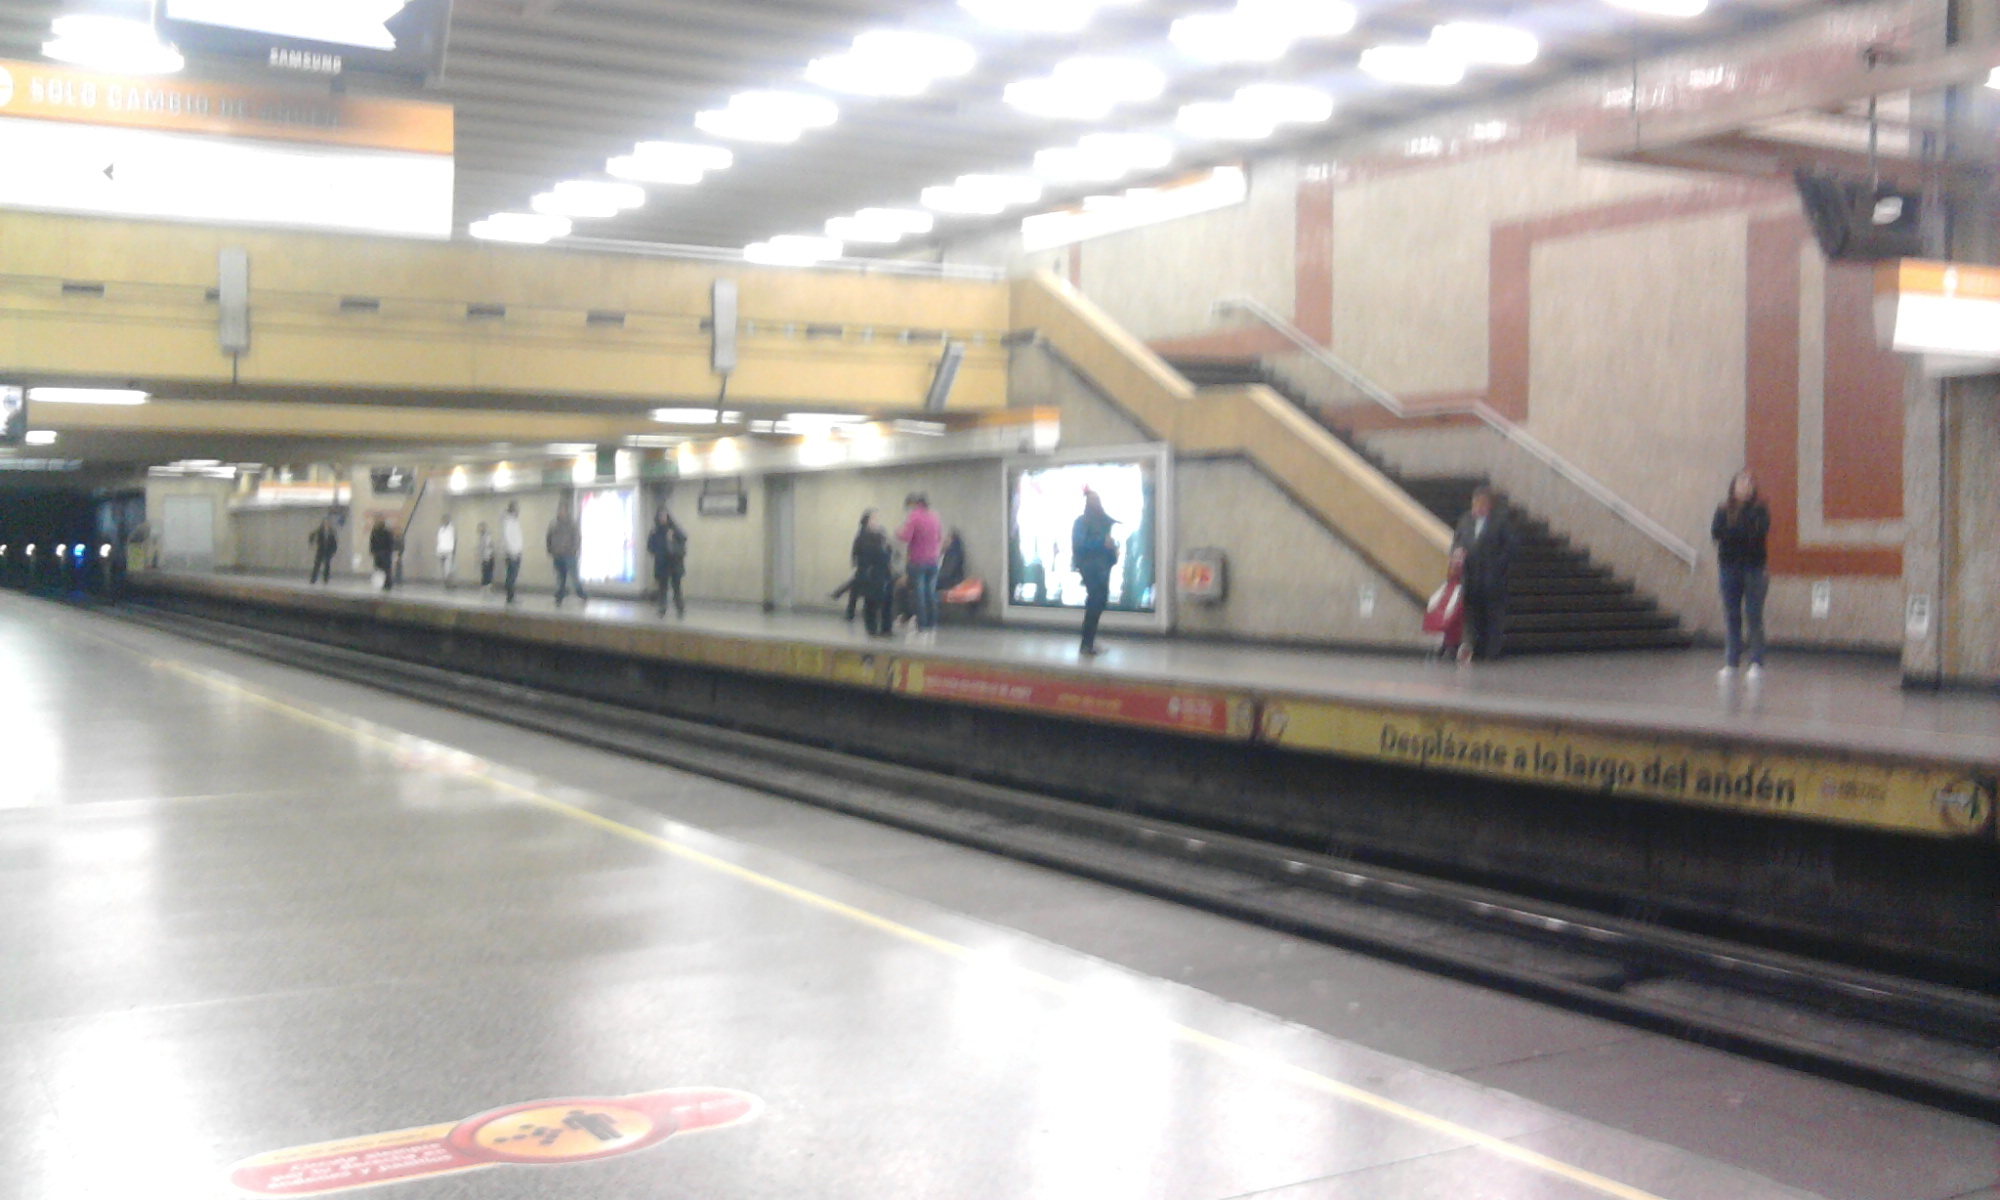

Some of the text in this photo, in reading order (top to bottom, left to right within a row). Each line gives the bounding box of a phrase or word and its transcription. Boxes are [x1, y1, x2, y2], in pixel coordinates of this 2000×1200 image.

[269, 47, 342, 75] SAMSUNG
[29, 76, 98, 107] SOLO
[107, 83, 210, 117] CAMBIO
[1380, 723, 1507, 768] Desplázate
[1513, 746, 1528, 772] a
[1534, 741, 1559, 773] lo
[1564, 744, 1636, 791] largo
[1642, 754, 1689, 790] del
[1695, 764, 1797, 804] andén
